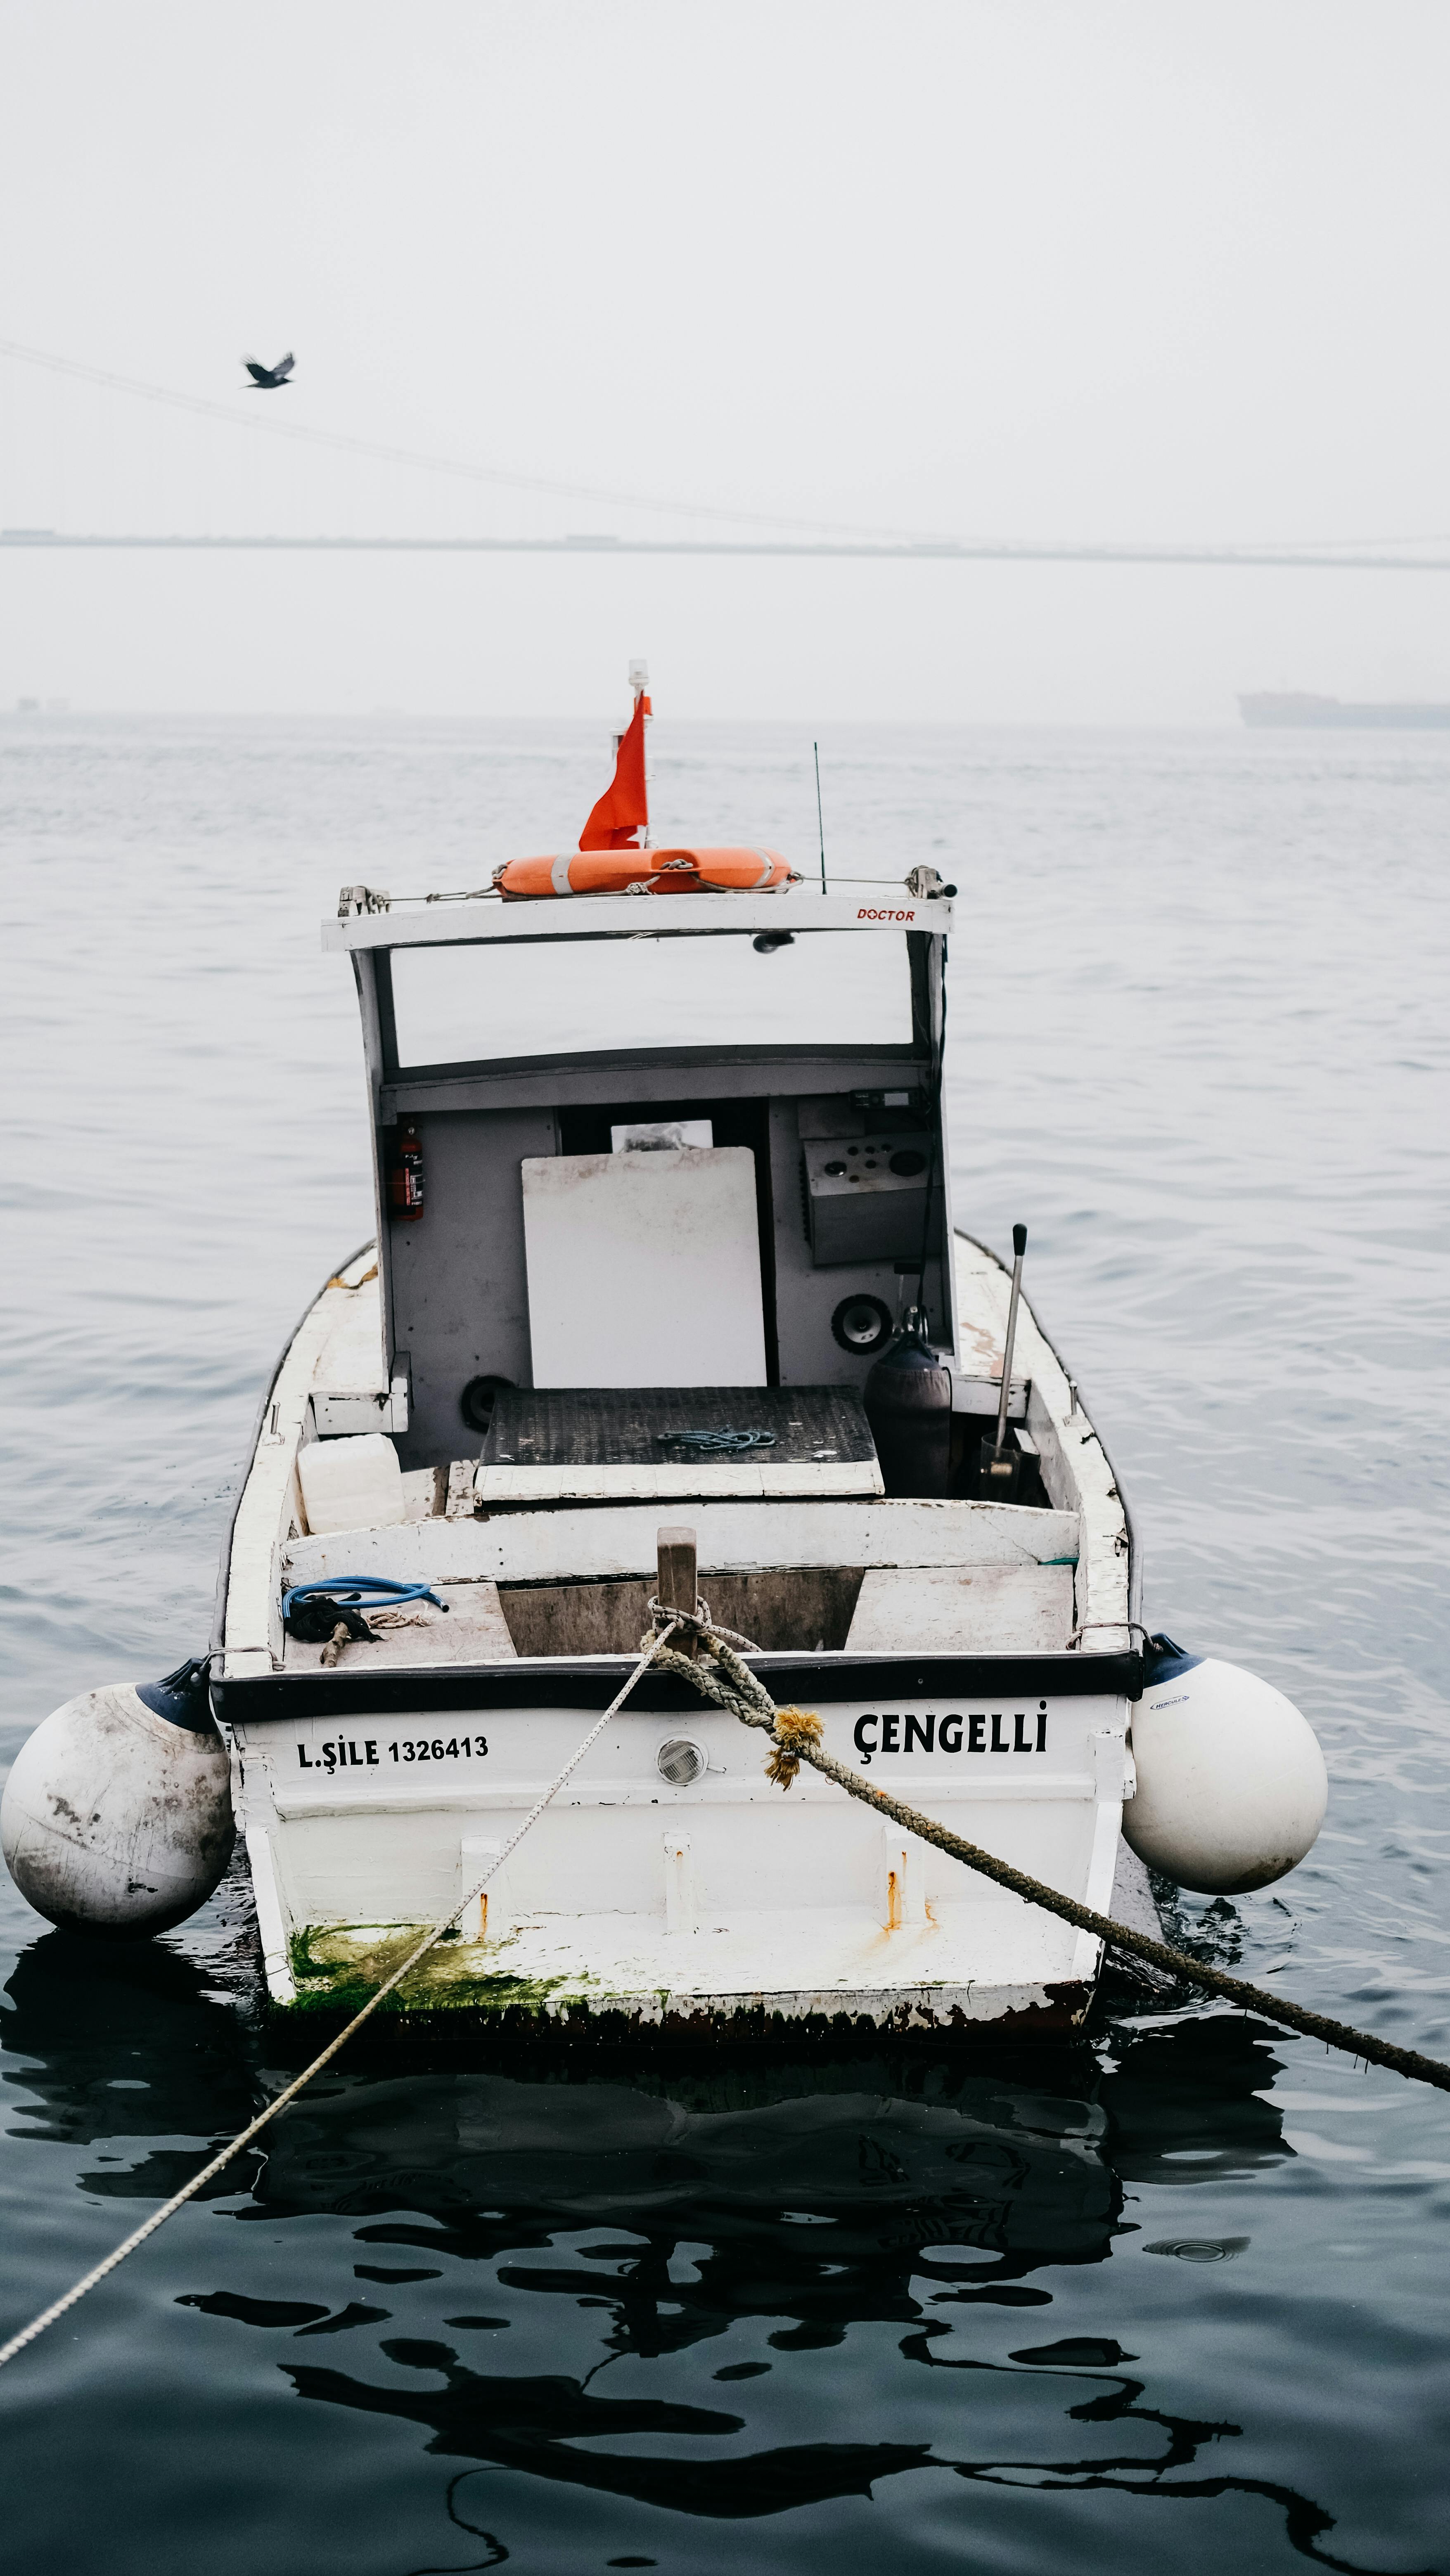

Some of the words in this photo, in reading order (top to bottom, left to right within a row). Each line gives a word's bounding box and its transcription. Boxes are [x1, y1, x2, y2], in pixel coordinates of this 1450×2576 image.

[857, 909, 915, 921] DOCTOR
[1156, 1696, 1189, 1709] HERCULES
[853, 1700, 1047, 1765] ÇENGELLİ
[297, 1734, 379, 1775] L.ŞİLE
[389, 1736, 488, 1762] 1326413
